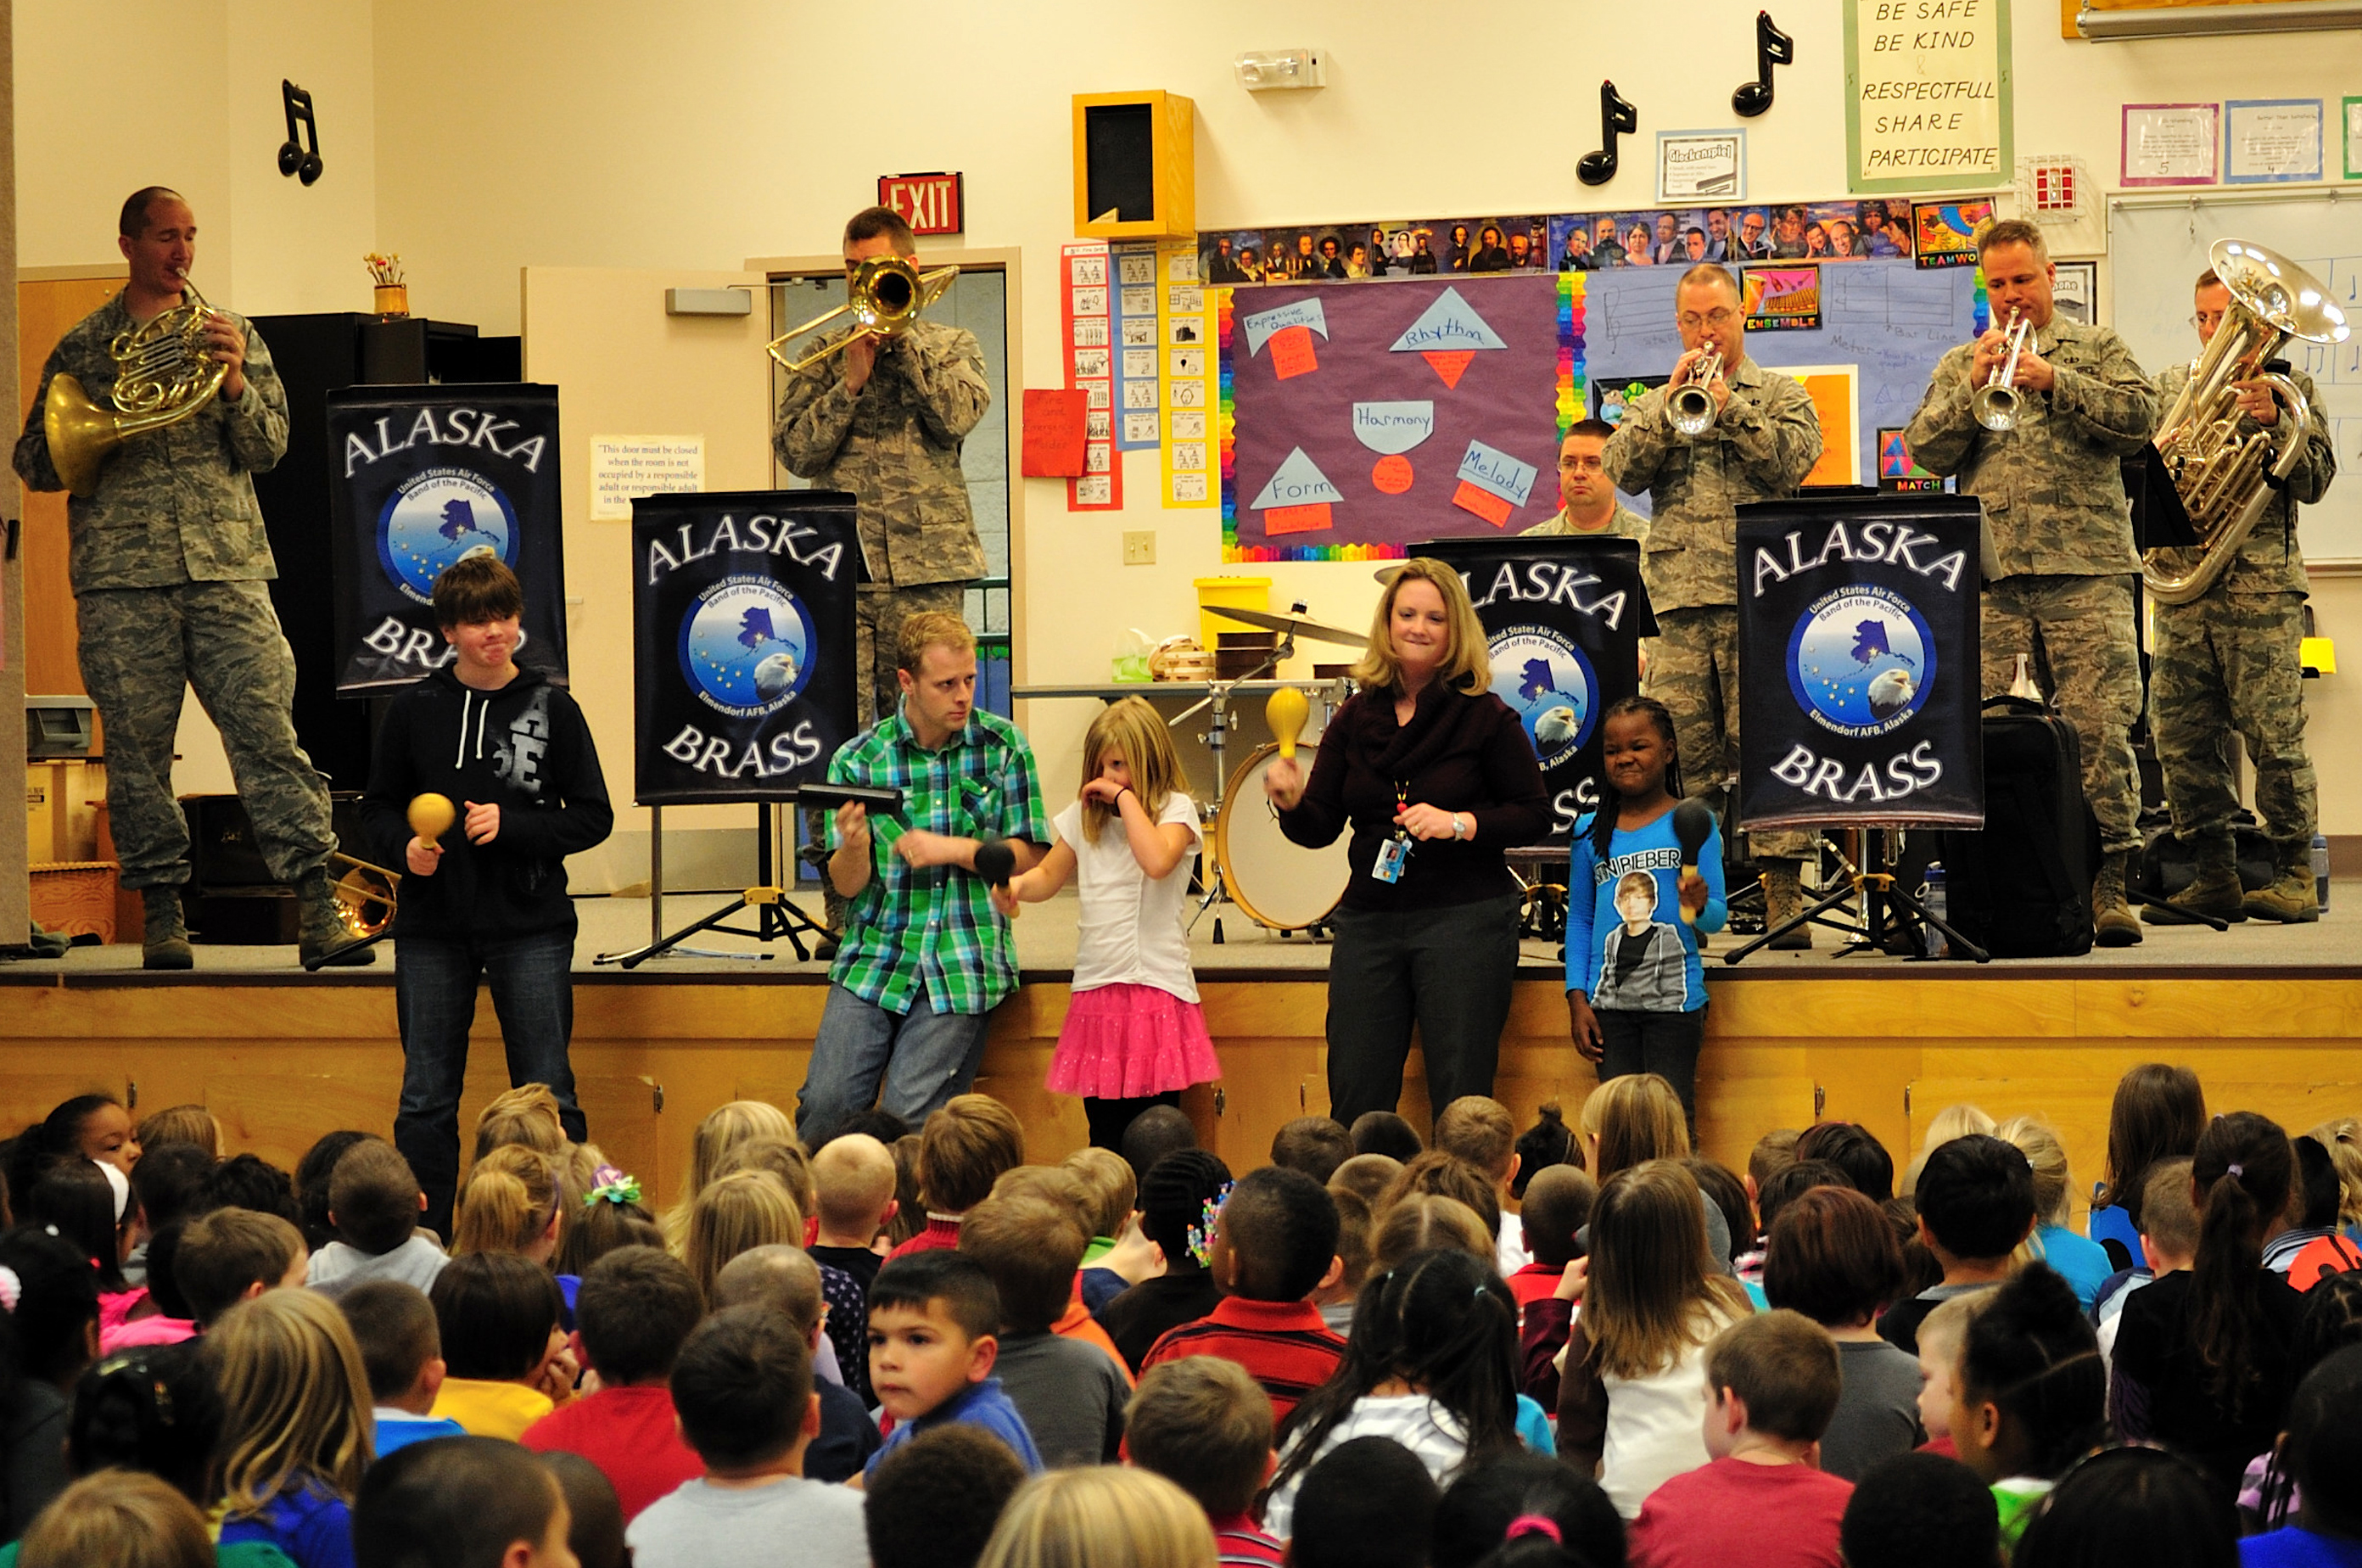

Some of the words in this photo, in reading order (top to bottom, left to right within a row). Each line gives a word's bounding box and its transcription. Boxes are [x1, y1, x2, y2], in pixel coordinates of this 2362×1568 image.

[1876, 3, 1906, 20] BE
[1916, 0, 1979, 19] SAFE
[1873, 34, 1904, 52] BE
[1913, 31, 1975, 49] KIND
[1861, 81, 1995, 100] RESPECTFUL
[1874, 113, 1963, 133] SHARE
[1668, 143, 1732, 163] Glockenspiel
[1867, 148, 1998, 167] PARTICIPATE
[2158, 160, 2170, 175] 5
[889, 181, 951, 229] EXIT
[1920, 253, 1977, 266] TEAMWO
[1246, 308, 1304, 329] Expressive
[1747, 317, 1816, 330] ENSEMBLE
[1405, 317, 1483, 345] Rhythm
[1357, 407, 1430, 434] Harmony
[344, 408, 547, 479] ALASKA
[621, 445, 640, 454] door
[663, 445, 673, 454] be
[674, 445, 697, 455] closed
[607, 458, 630, 467] when
[631, 458, 644, 467] the
[668, 458, 674, 467] is
[397, 472, 425, 494] United
[427, 468, 456, 478] States
[458, 468, 470, 479] Air
[472, 473, 495, 494] Force
[598, 470, 634, 481] occupied
[635, 470, 644, 481] by
[653, 470, 698, 481] responsible
[1463, 451, 1527, 501] Melody
[1897, 479, 1940, 491] MATCH
[406, 484, 430, 501] Band
[431, 479, 440, 489] of
[442, 479, 458, 487] the
[459, 480, 489, 501] Pacific
[603, 495, 612, 504] in
[613, 496, 626, 504] the
[1271, 477, 1335, 501] Form
[648, 513, 845, 585] ALASKA
[1753, 520, 1967, 598] ALASKA
[697, 579, 727, 602] United
[726, 575, 756, 585] States
[757, 575, 772, 586] Air
[771, 580, 794, 601] Force
[707, 591, 730, 608] Band
[730, 586, 740, 596] of
[742, 586, 758, 595] the
[759, 588, 786, 608] Pacific
[1458, 561, 1627, 631] LASKA
[1809, 590, 1839, 614] United
[1839, 586, 1870, 597] States
[1871, 586, 1887, 597] Air
[1886, 591, 1911, 613] Force
[1818, 602, 1842, 622] Band
[1844, 598, 1853, 608] of
[1855, 597, 1872, 607] the
[1872, 599, 1903, 621] Pacific
[1508, 624, 1536, 636] States
[1536, 625, 1552, 637] Air
[1551, 630, 1576, 652] Force
[1511, 637, 1520, 646] of
[1522, 636, 1537, 645] the
[1538, 638, 1568, 659] Pacific
[768, 690, 798, 713] Alaska
[1809, 708, 1859, 736] Elmendorf
[1883, 708, 1915, 732] Alaska
[662, 720, 824, 779] BRASS
[1549, 745, 1579, 770] Alaska
[1769, 739, 1944, 804] BRASS
[1619, 848, 1682, 873] BIEBER
